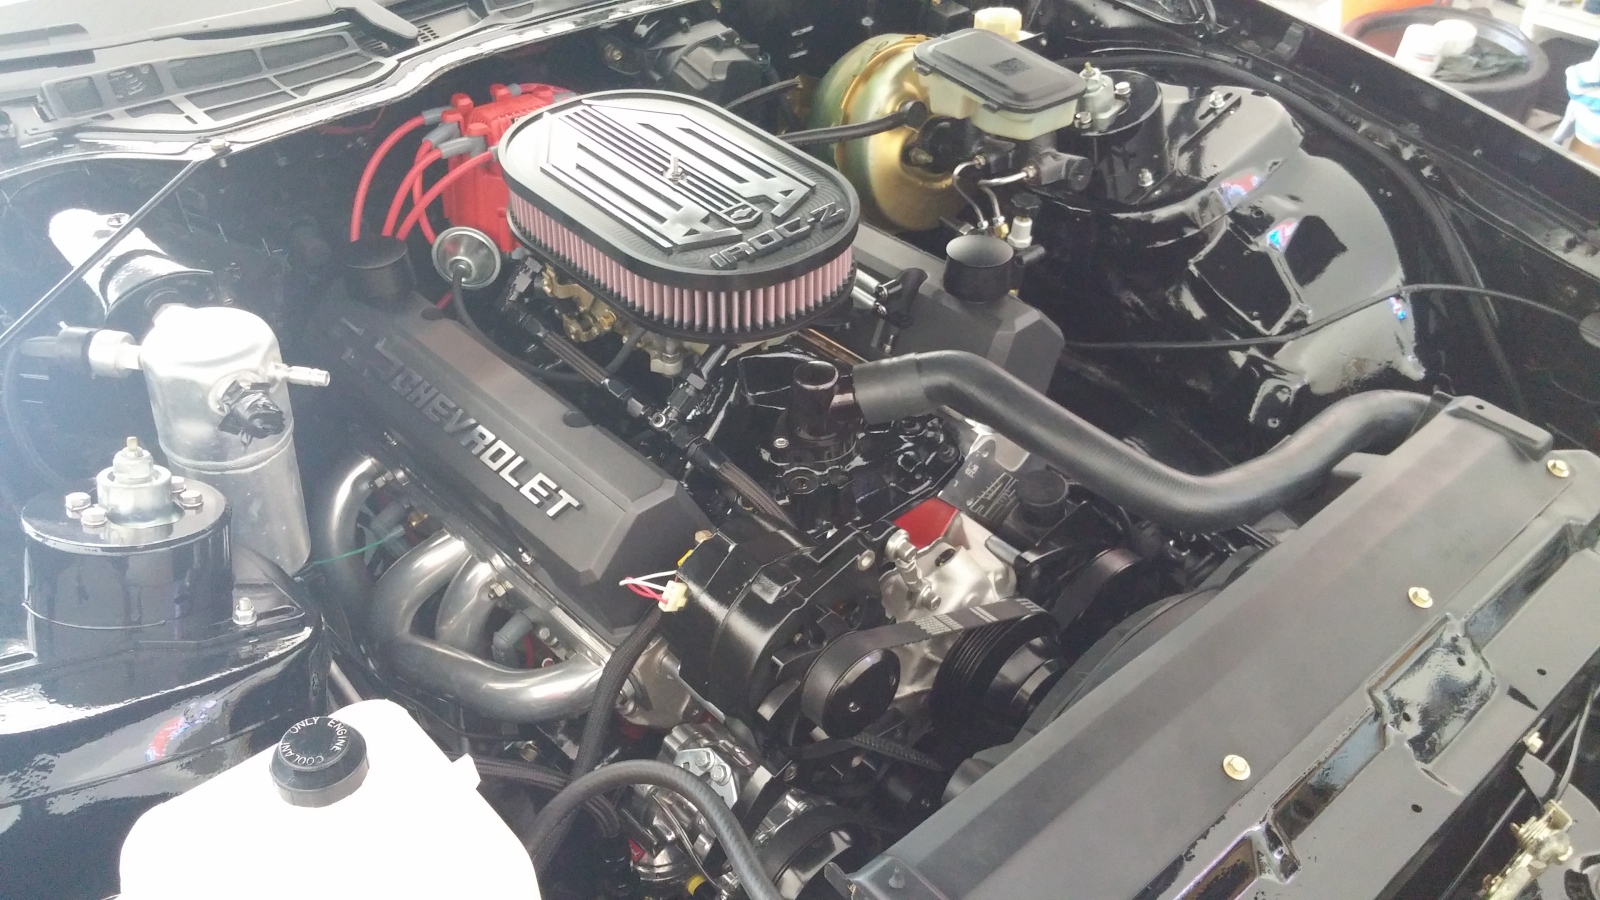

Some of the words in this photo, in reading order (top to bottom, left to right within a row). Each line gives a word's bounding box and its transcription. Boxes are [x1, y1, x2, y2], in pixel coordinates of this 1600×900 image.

[709, 201, 845, 268] IROC-Z
[390, 367, 582, 519] CHEVROLET
[288, 715, 320, 734] ONLY
[326, 717, 348, 752] ENGINE
